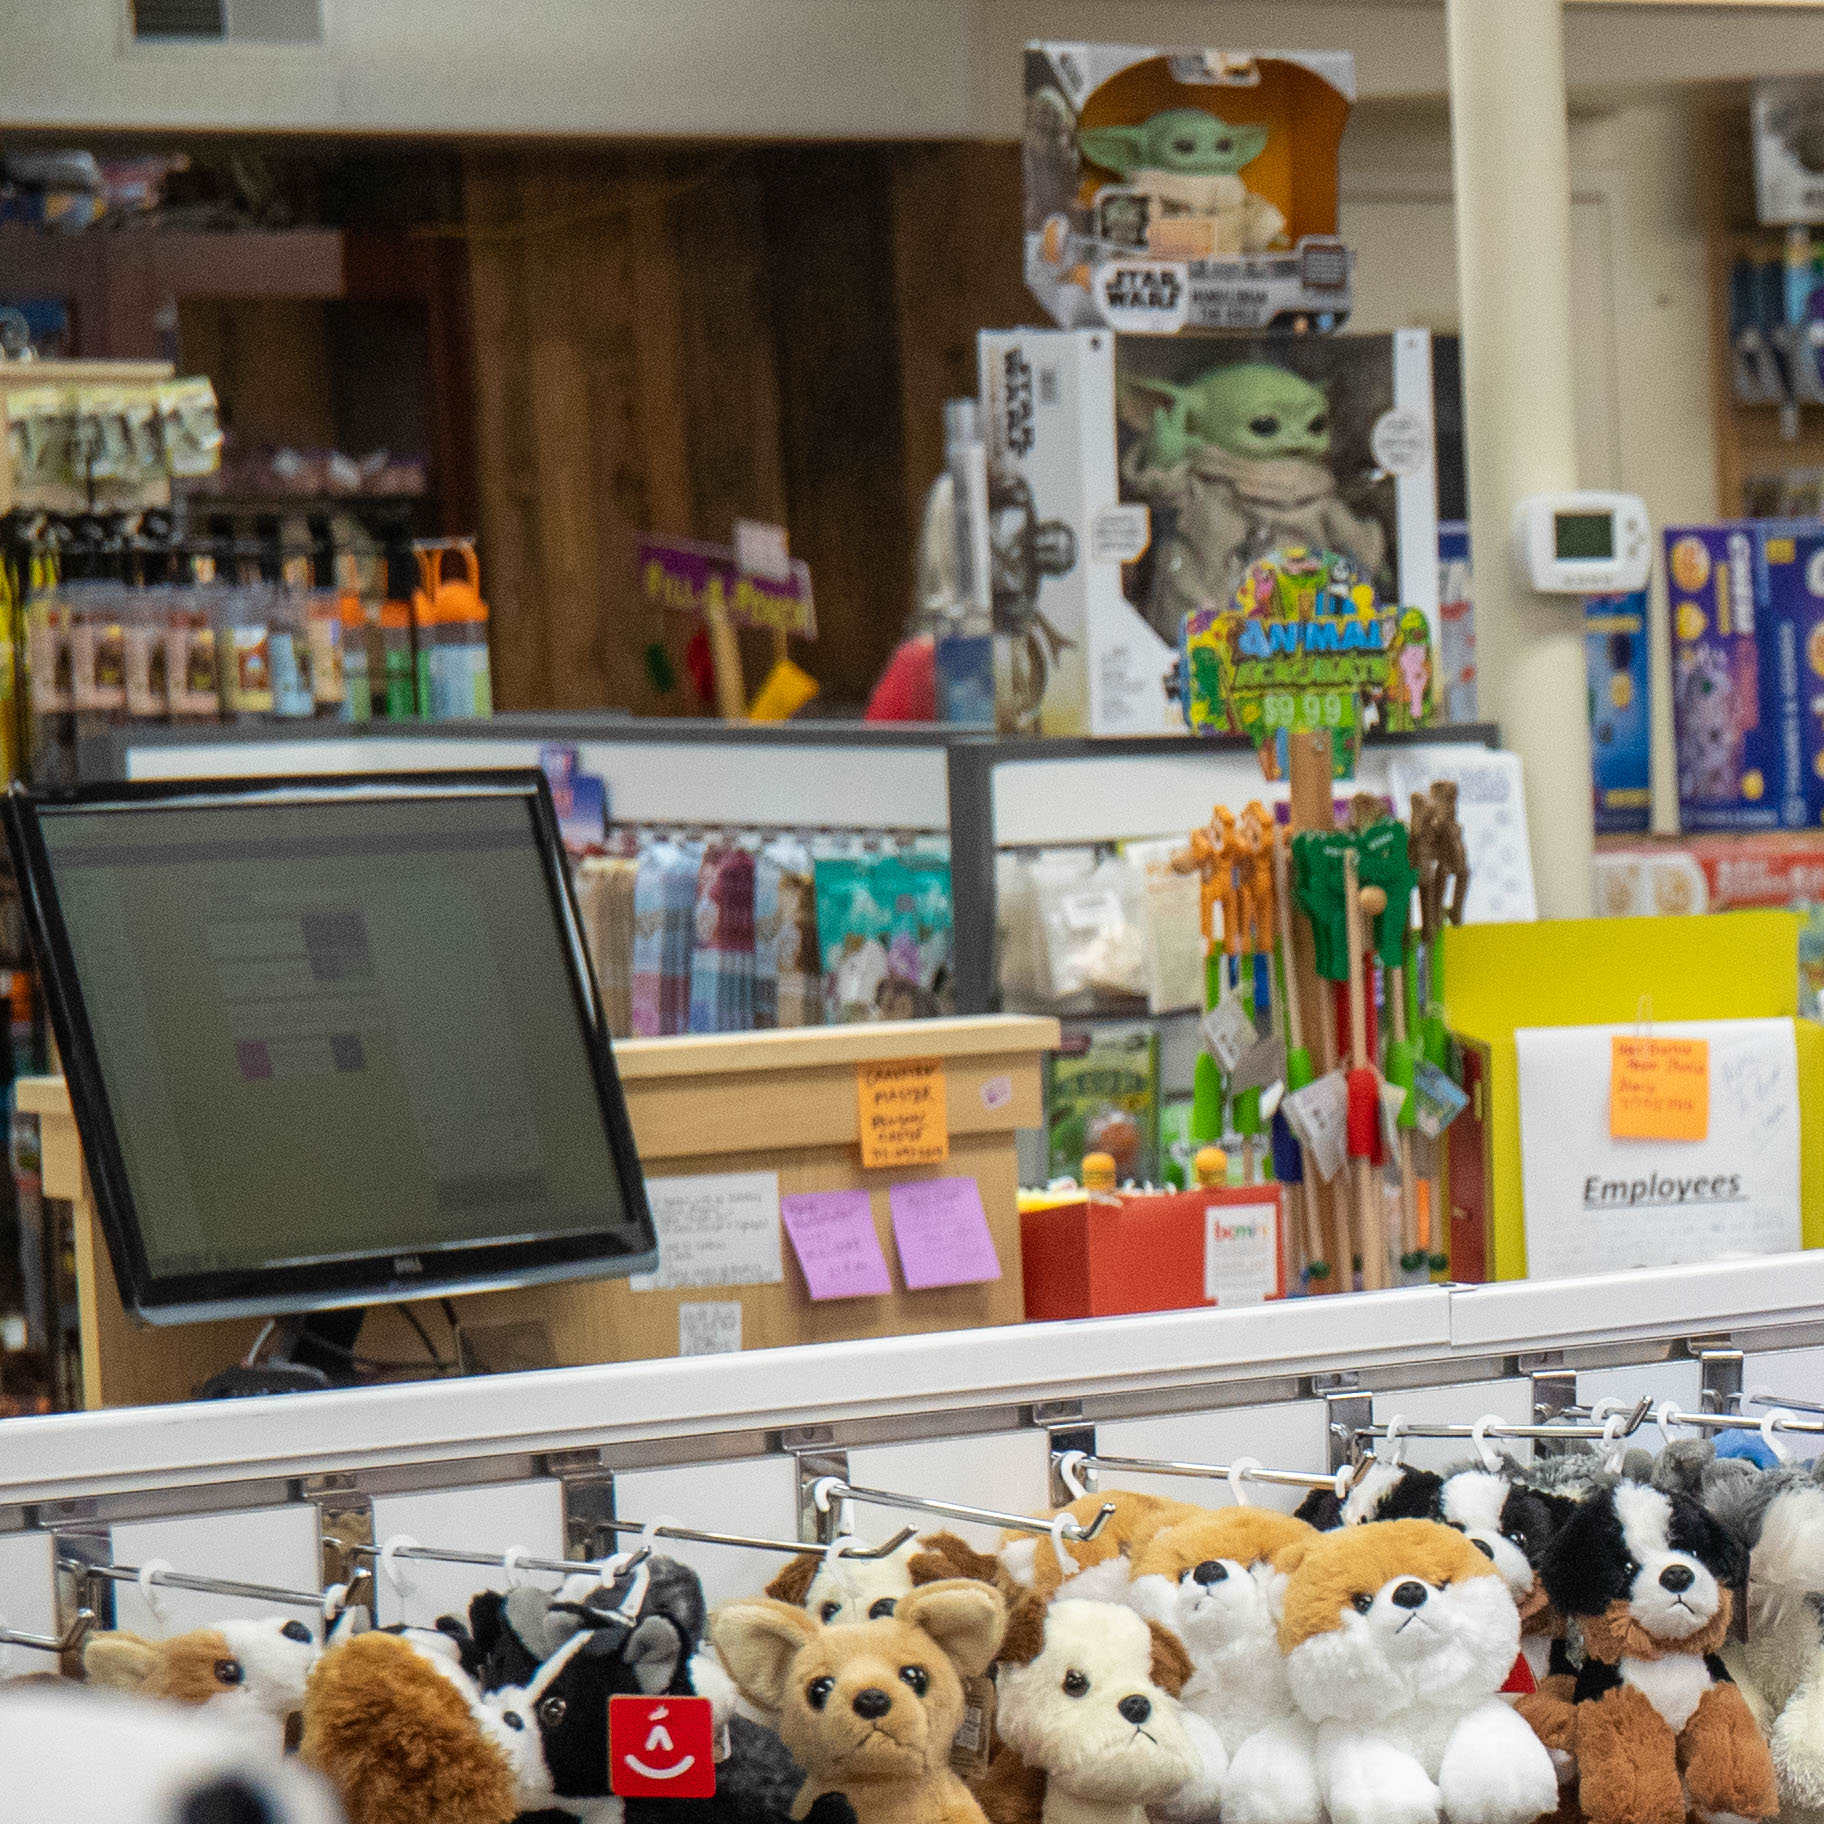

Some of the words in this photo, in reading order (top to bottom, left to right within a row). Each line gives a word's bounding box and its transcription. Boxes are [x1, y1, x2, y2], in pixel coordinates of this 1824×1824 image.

[1109, 269, 1181, 294] STAR
[1107, 290, 1180, 310] WARS
[1584, 1169, 1741, 1206] Employees
